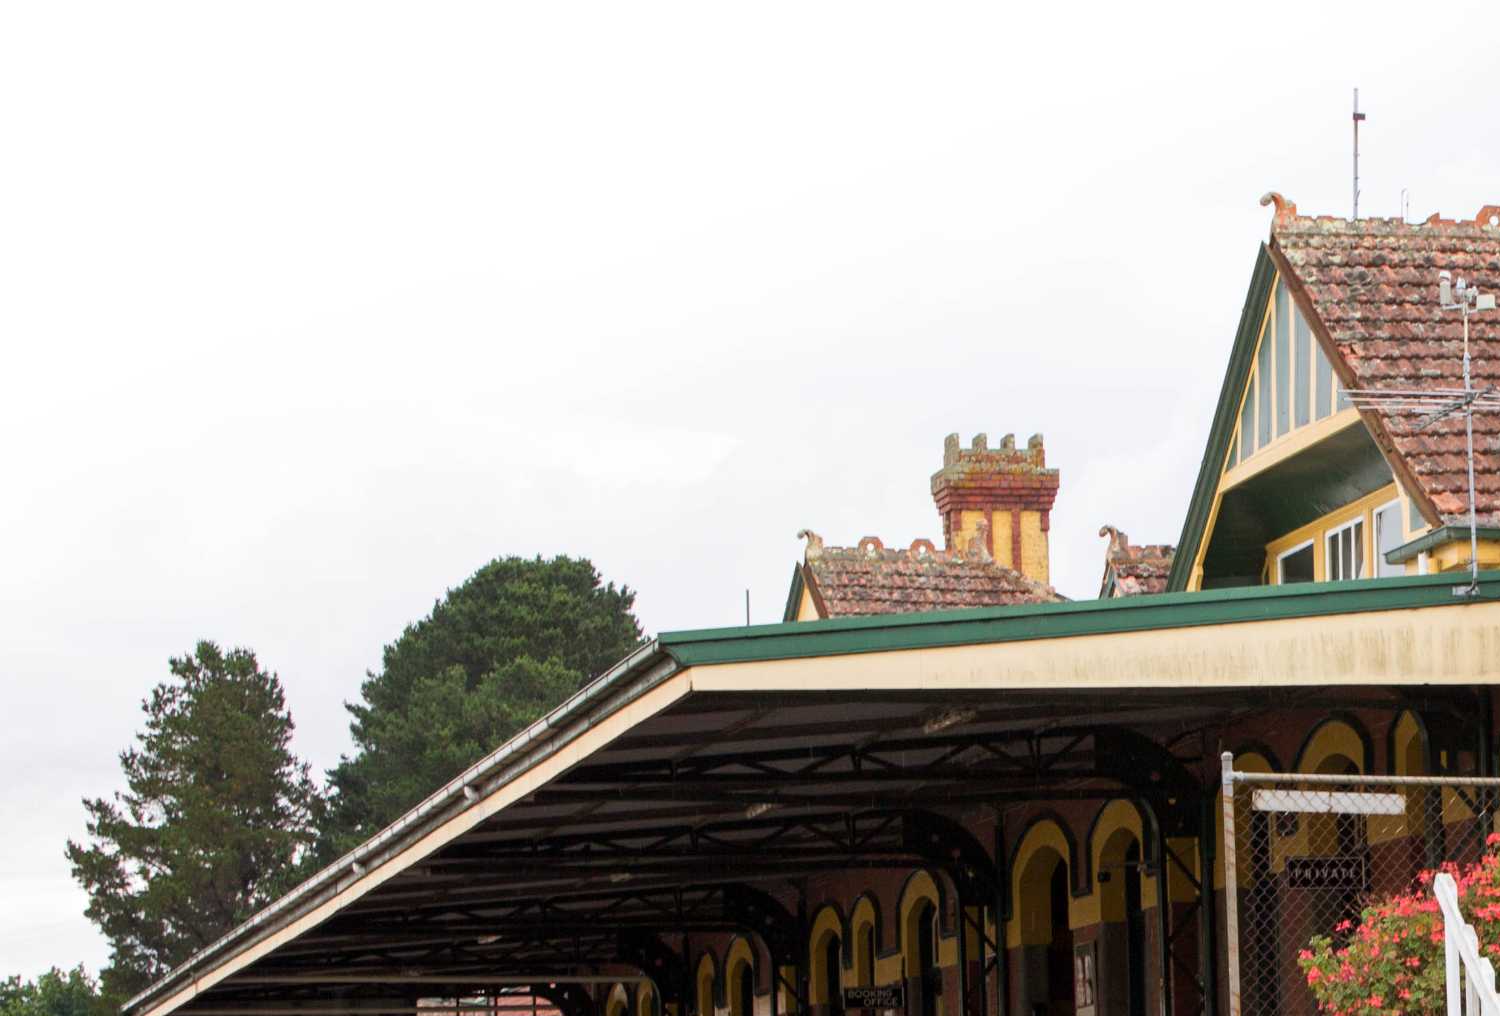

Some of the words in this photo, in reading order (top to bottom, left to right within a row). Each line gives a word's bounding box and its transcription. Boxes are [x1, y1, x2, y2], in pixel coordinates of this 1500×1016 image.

[1294, 867, 1356, 880] PRIVATE
[847, 990, 893, 1000] BOOKING
[864, 998, 897, 1008] OFFICE
